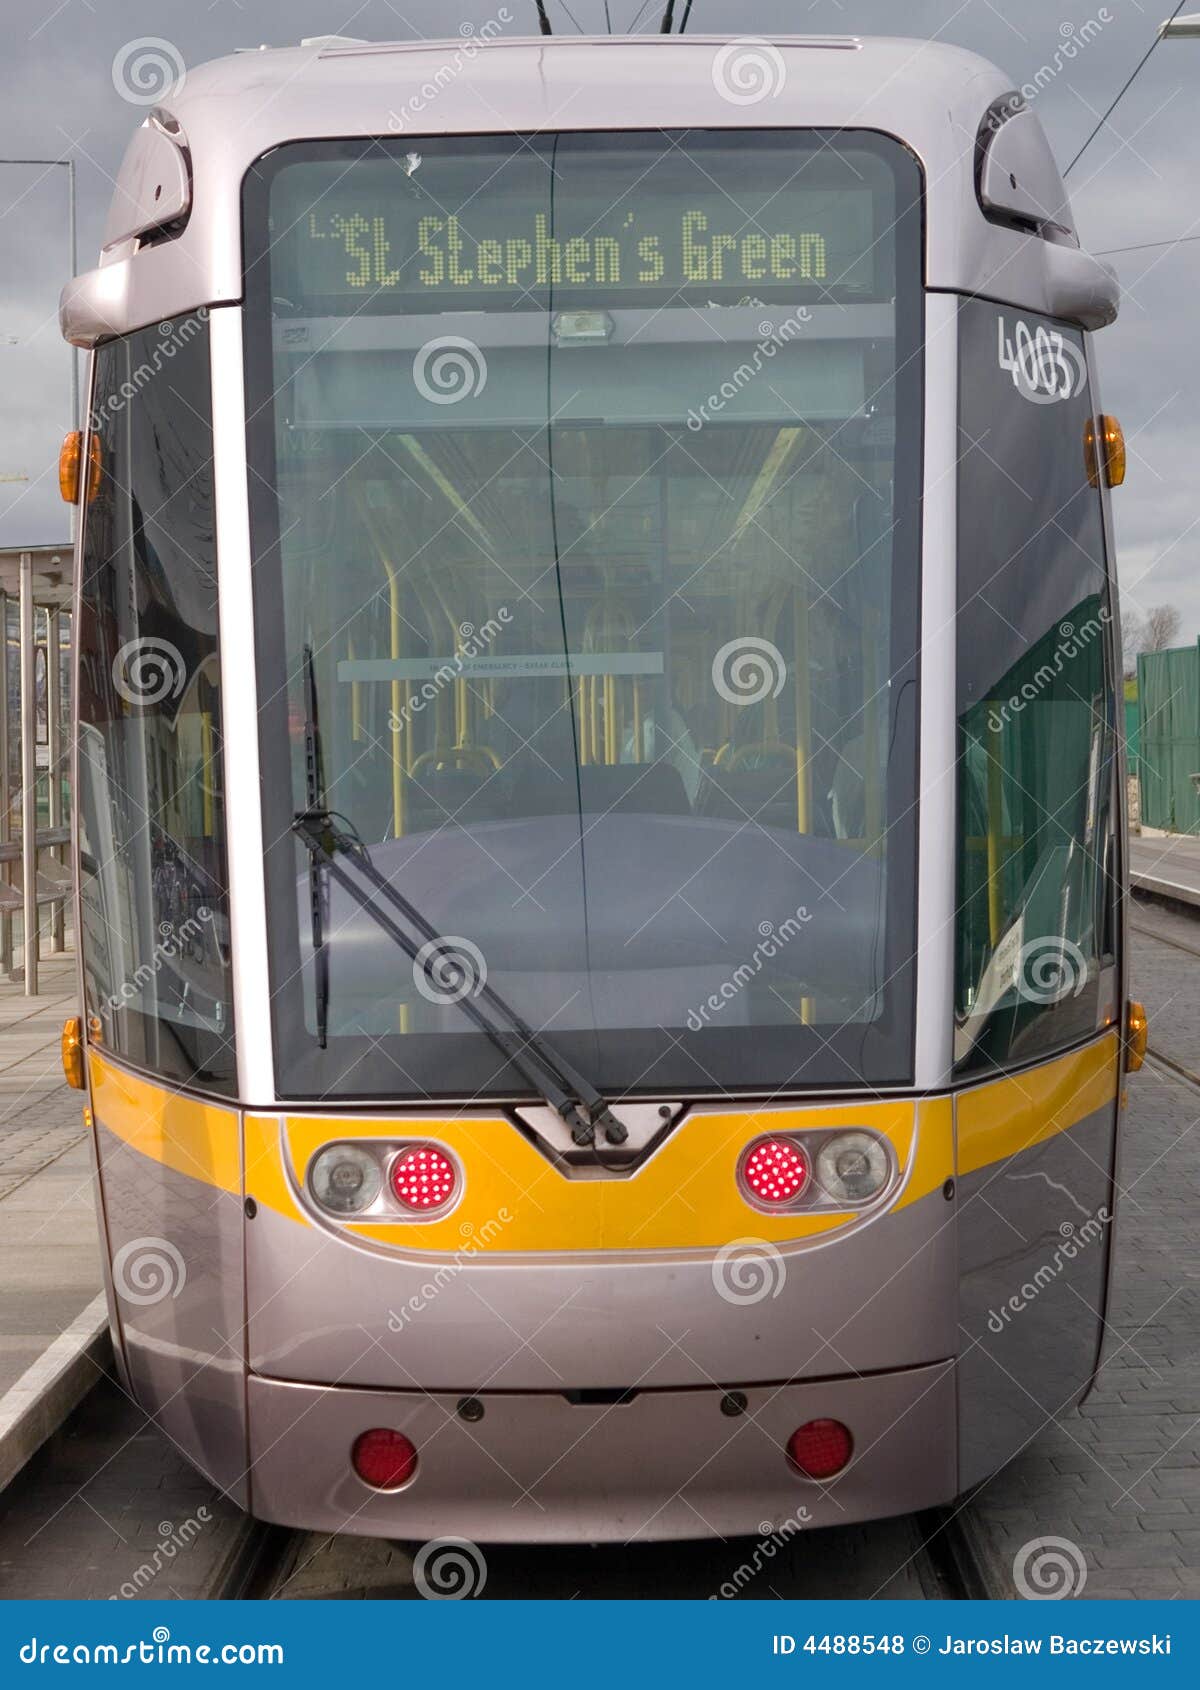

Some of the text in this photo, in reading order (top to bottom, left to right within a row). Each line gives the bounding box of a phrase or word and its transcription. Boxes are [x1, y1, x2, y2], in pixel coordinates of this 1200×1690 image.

[346, 210, 827, 287] St Stephen's Green
[998, 316, 1072, 400] 4003
